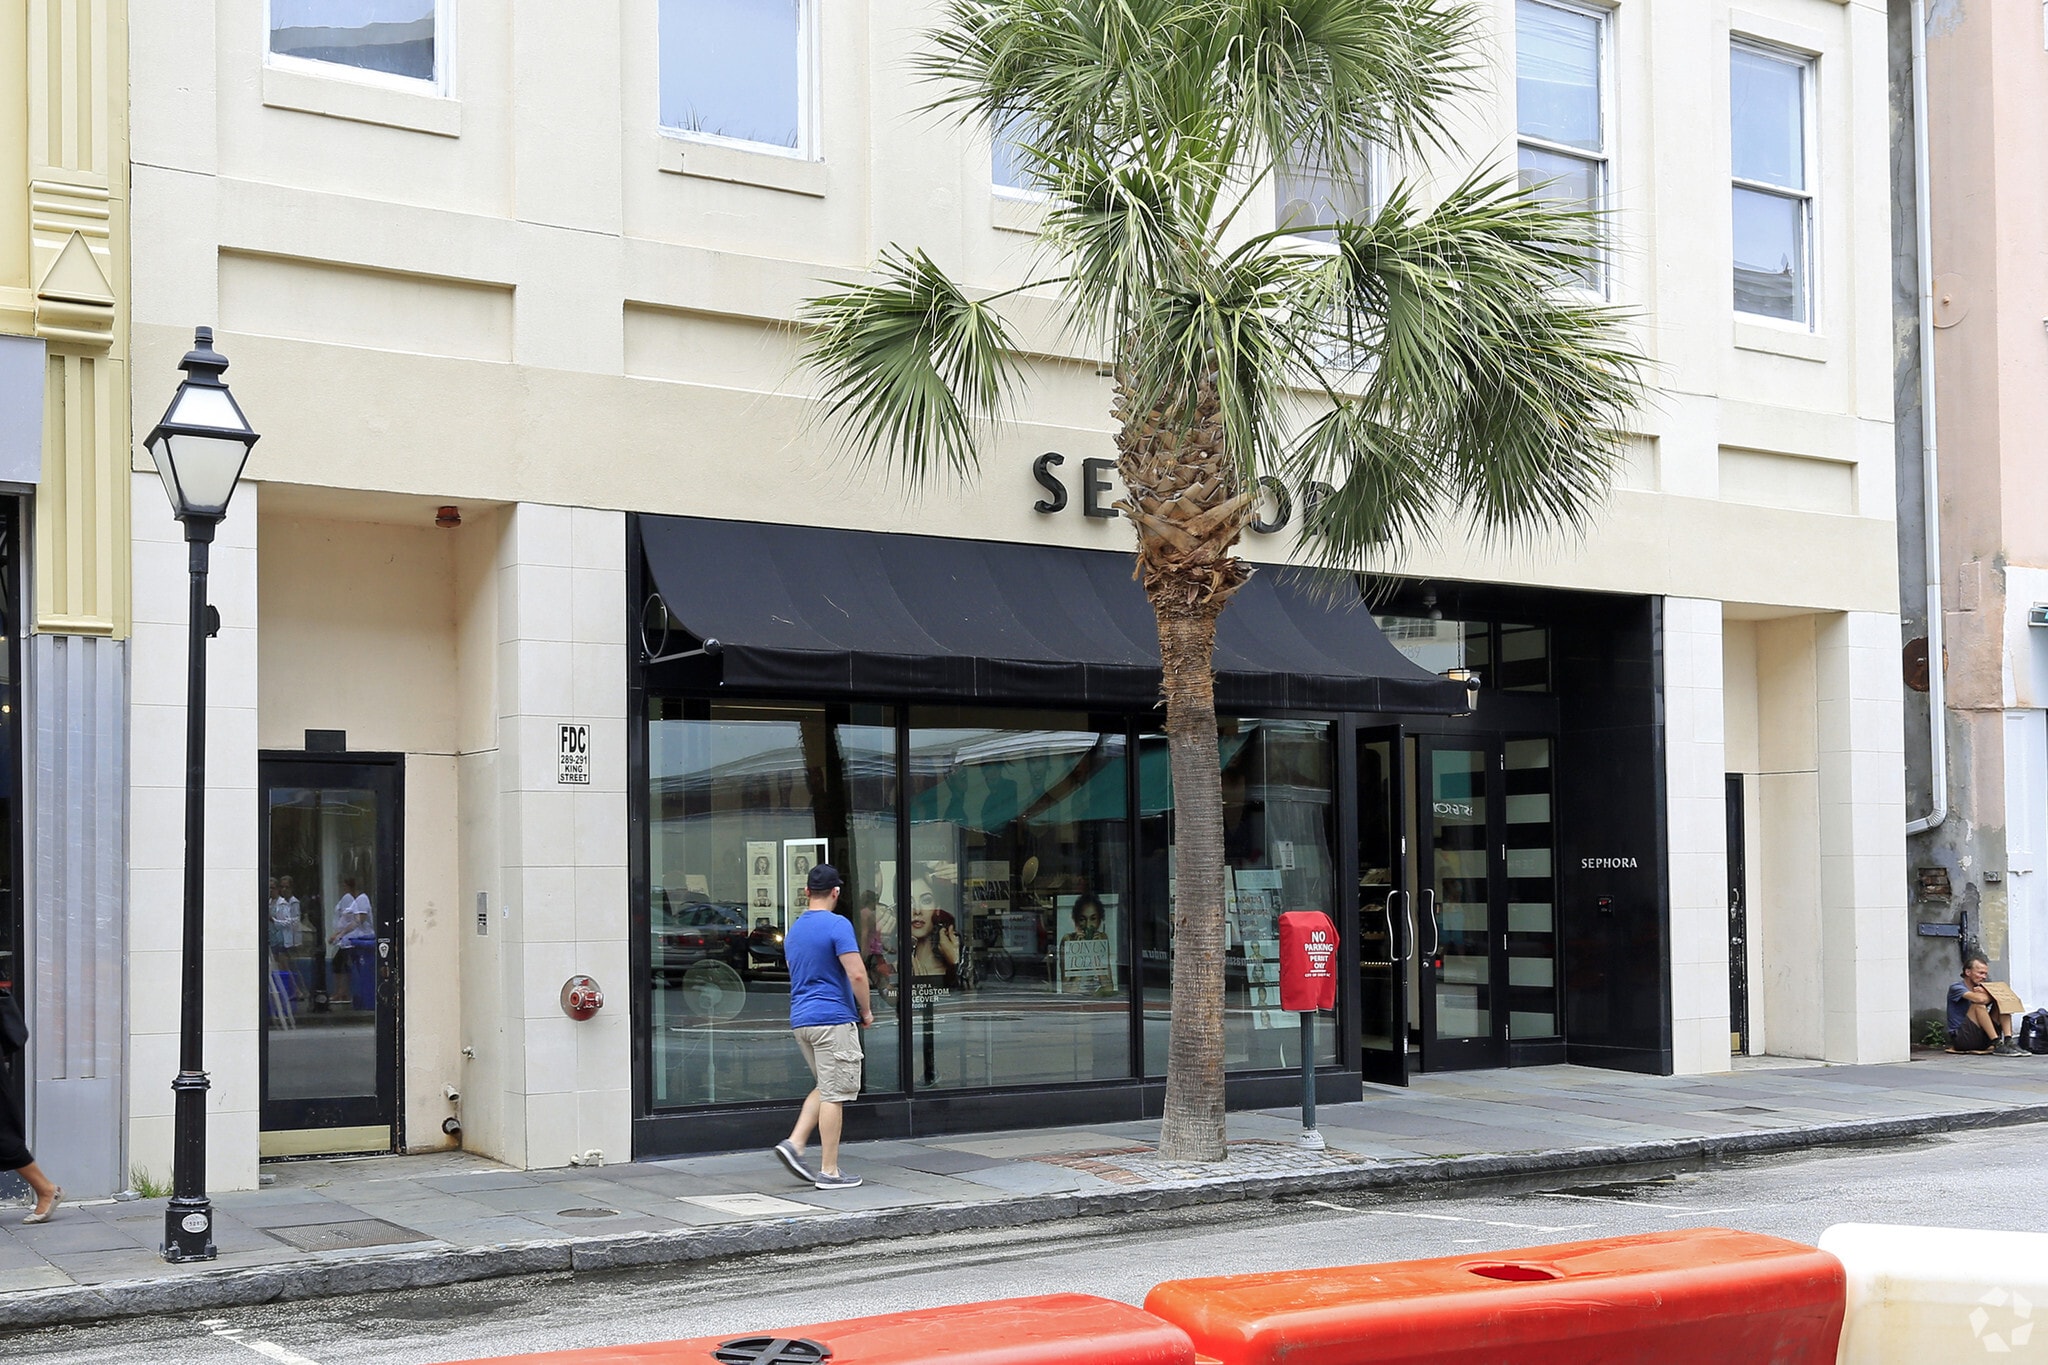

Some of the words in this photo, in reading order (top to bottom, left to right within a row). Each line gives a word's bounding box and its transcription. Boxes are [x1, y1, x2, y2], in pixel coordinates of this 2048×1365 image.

[1032, 452, 1388, 541] SEOR
[561, 726, 586, 753] FDC
[561, 755, 587, 764] 289-291
[565, 765, 583, 773] KING
[560, 773, 588, 782] STREET
[1581, 857, 1638, 869] SEPHORA
[1311, 931, 1326, 942] NO
[918, 987, 950, 996] CUSTOM
